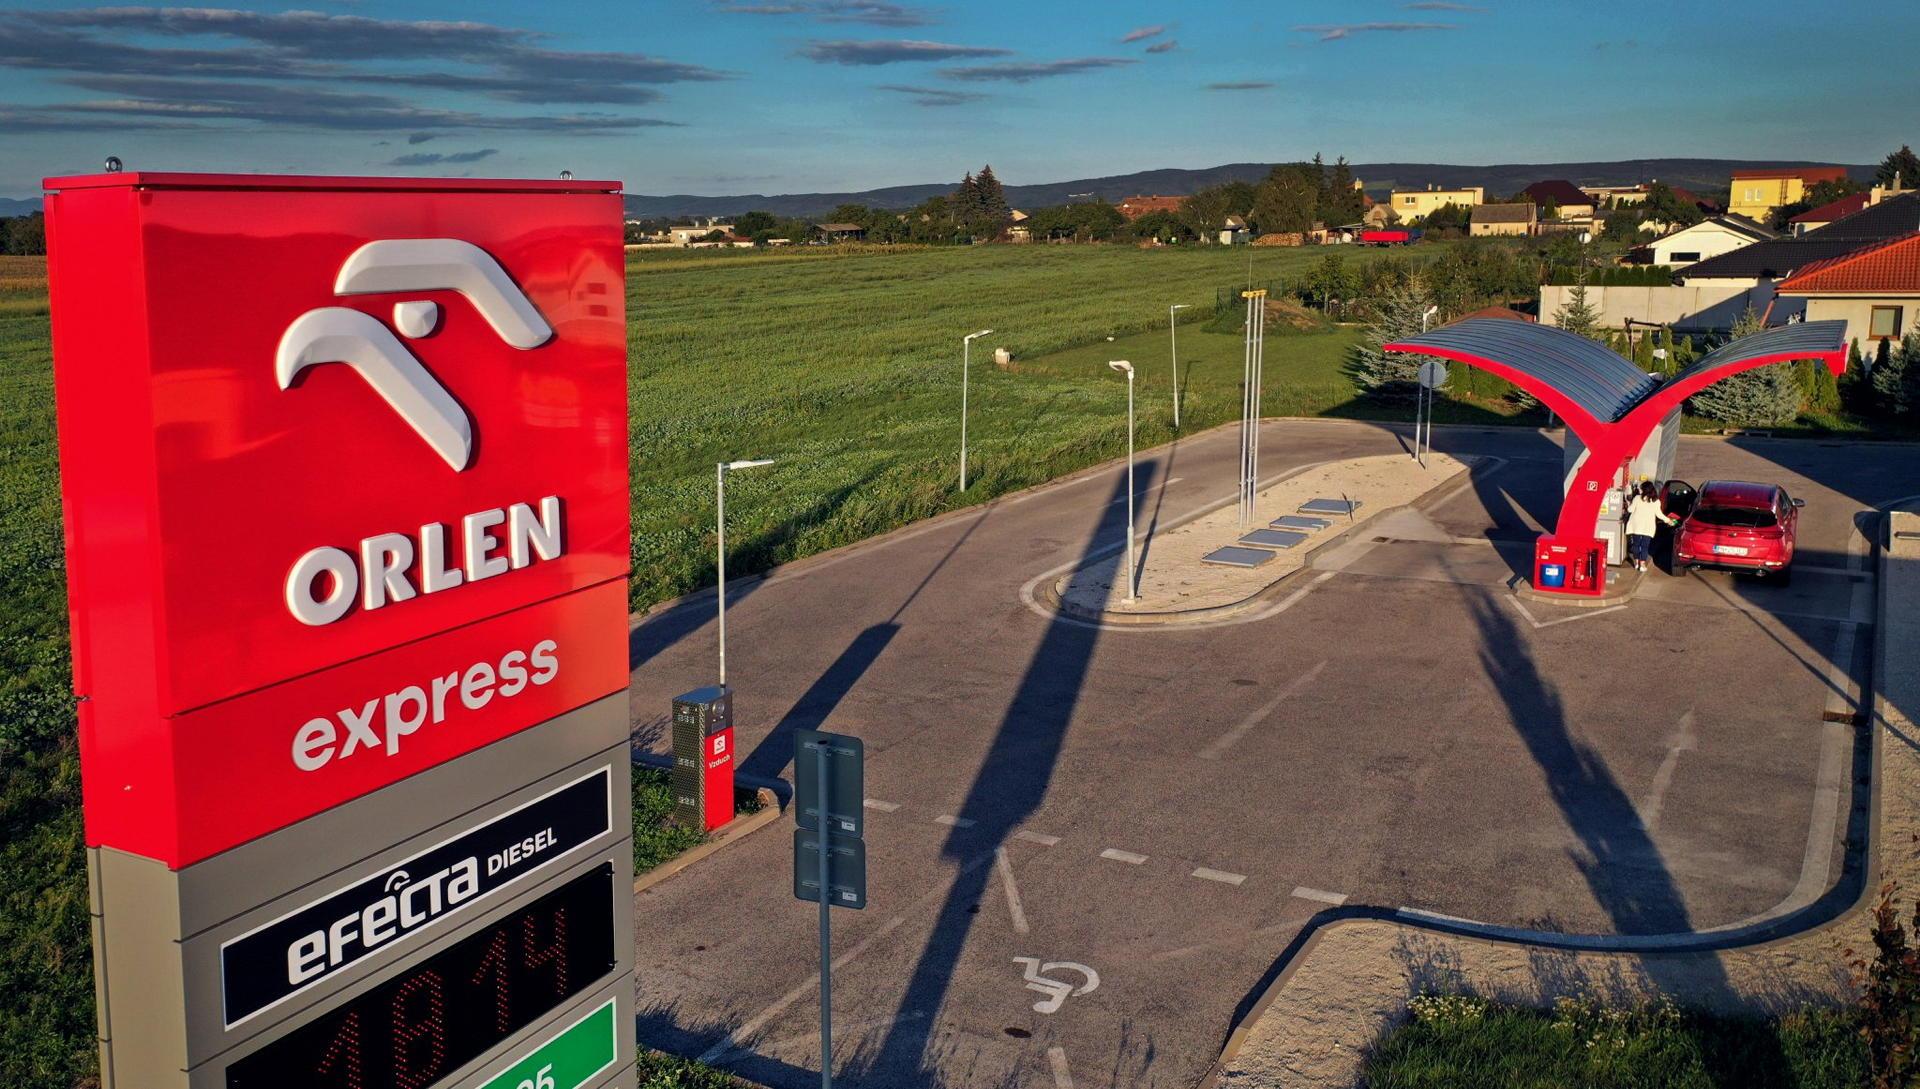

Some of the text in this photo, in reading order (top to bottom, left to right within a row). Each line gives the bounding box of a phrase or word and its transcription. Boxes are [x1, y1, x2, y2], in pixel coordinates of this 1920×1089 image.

[286, 495, 562, 626] ORLEN
[292, 639, 559, 771] express
[488, 827, 557, 877] DIESEL
